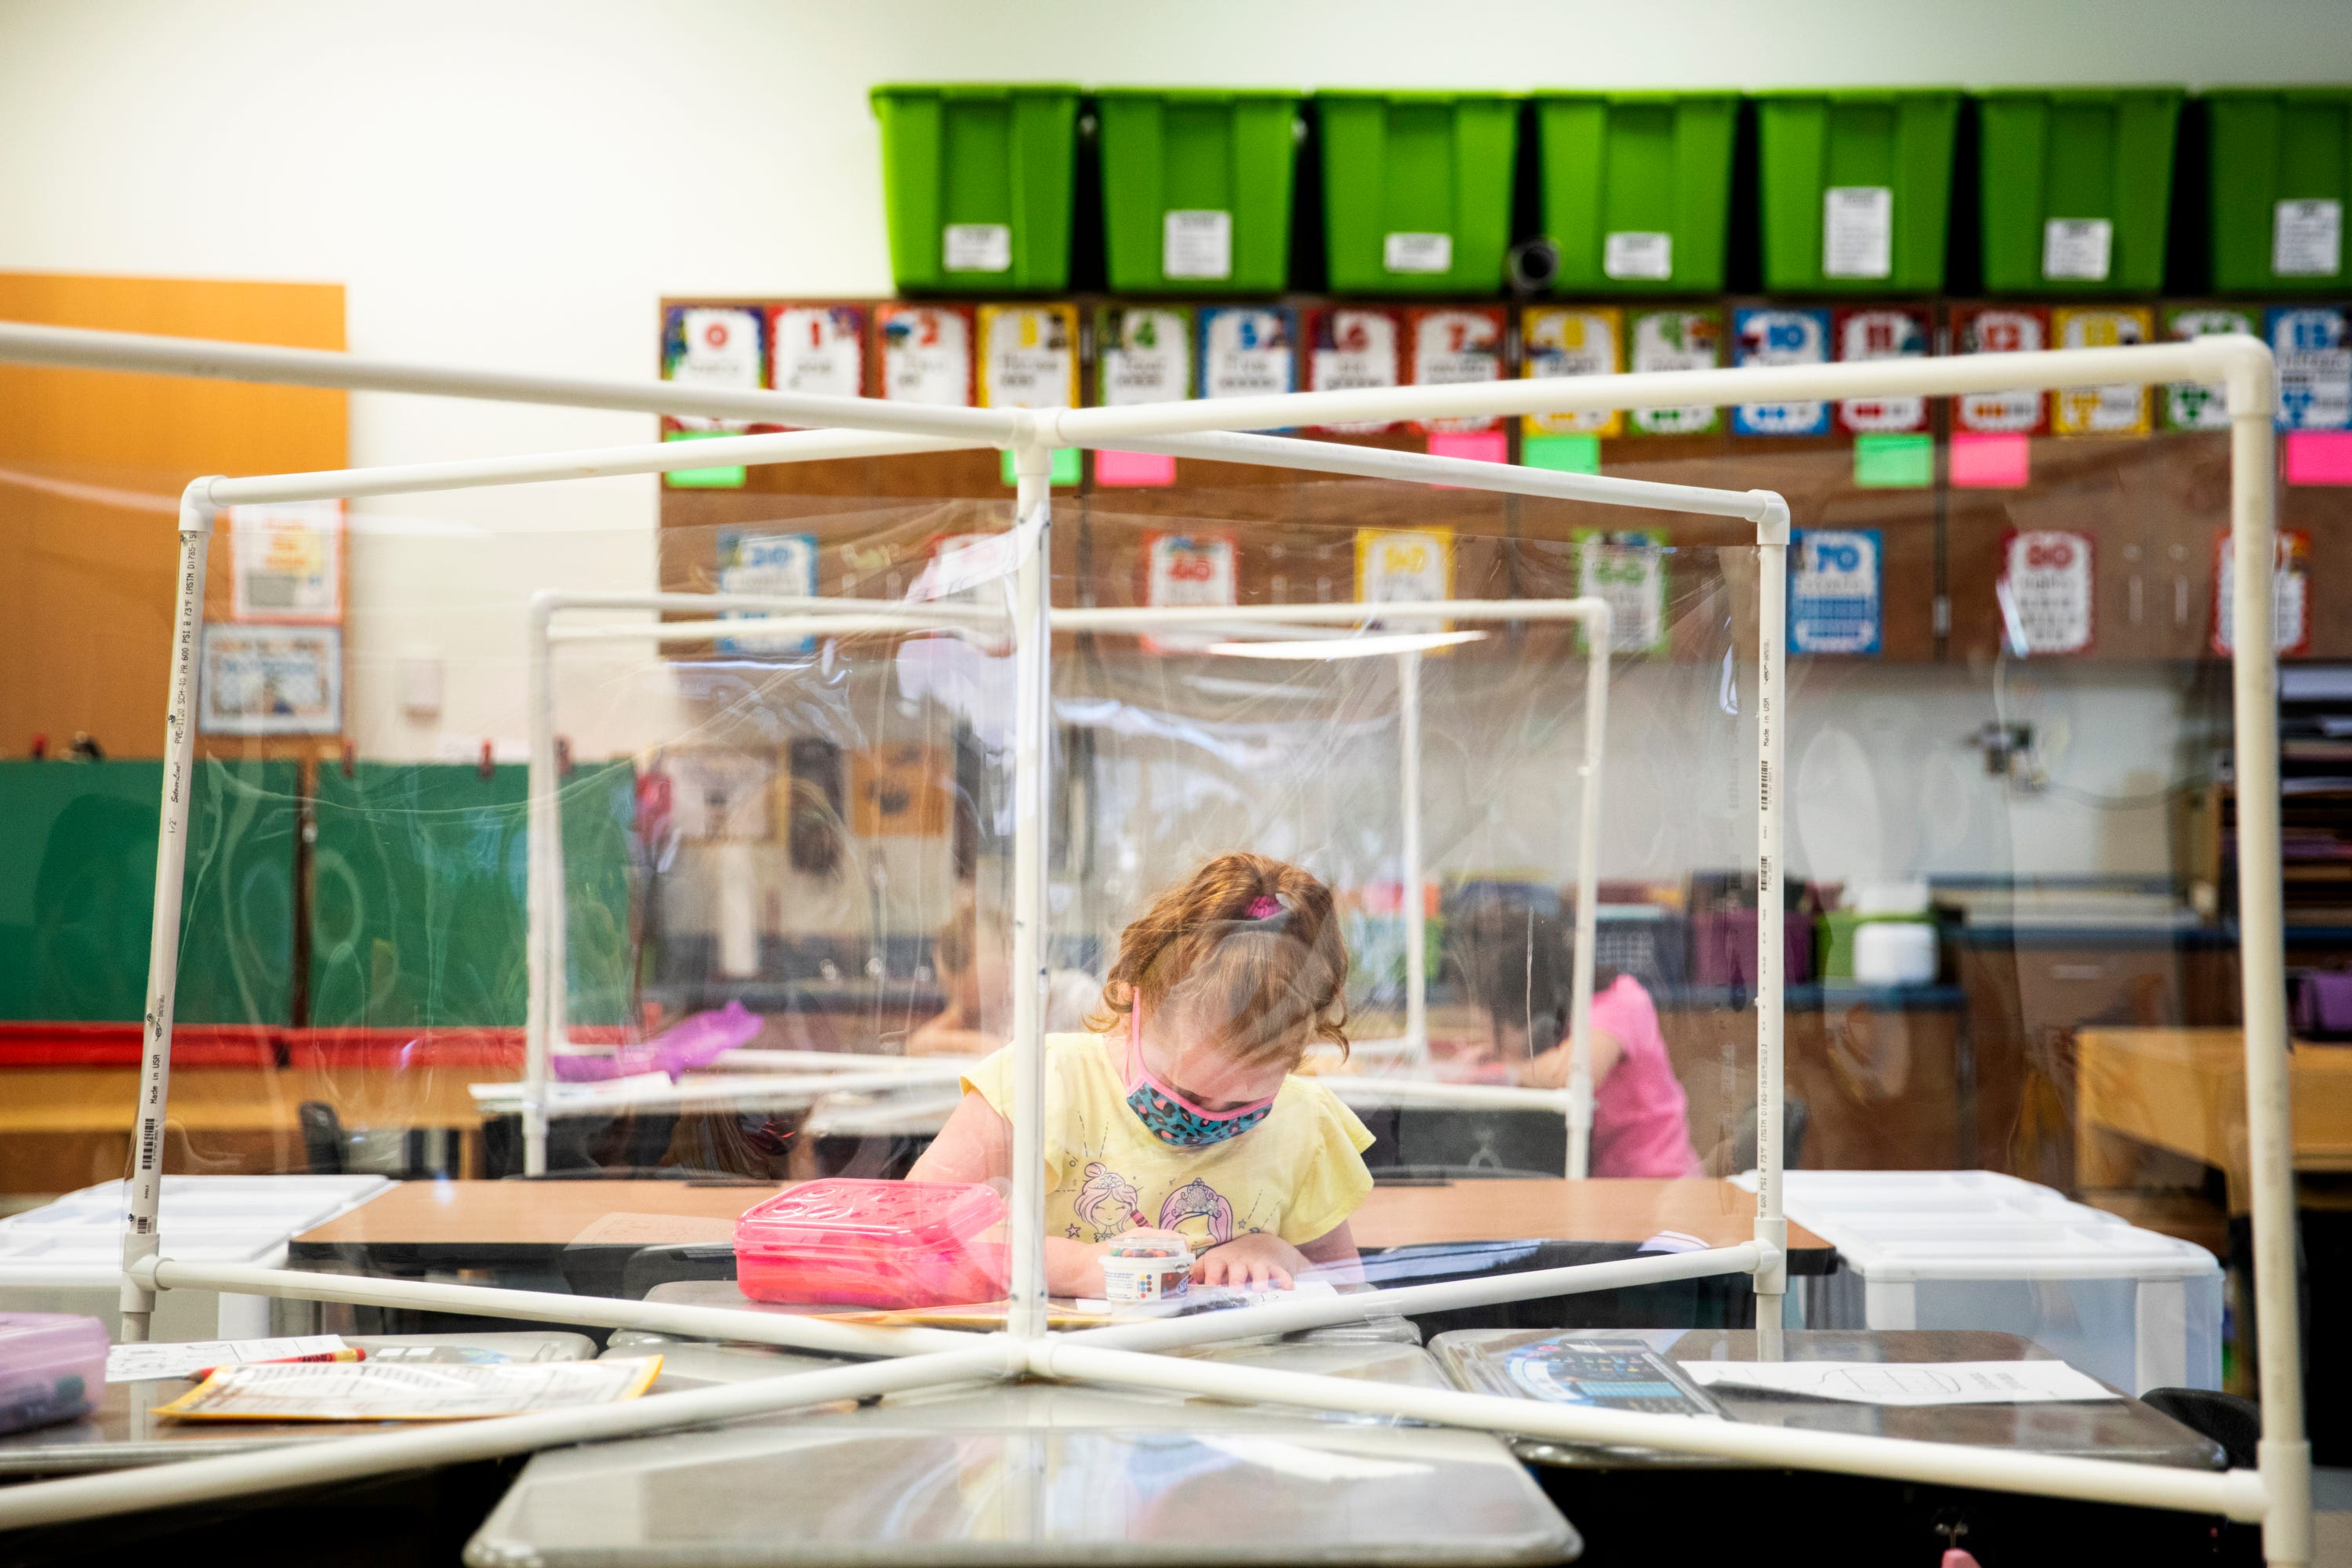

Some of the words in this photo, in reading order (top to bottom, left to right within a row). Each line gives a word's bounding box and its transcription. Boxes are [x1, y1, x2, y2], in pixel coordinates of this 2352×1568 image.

[182, 630, 191, 644] PSI
[180, 665, 188, 674] PR
[177, 678, 187, 704] SCH-40
[174, 709, 185, 744] PVC-1120
[152, 1054, 161, 1069] USA
[150, 1086, 158, 1104] Made
